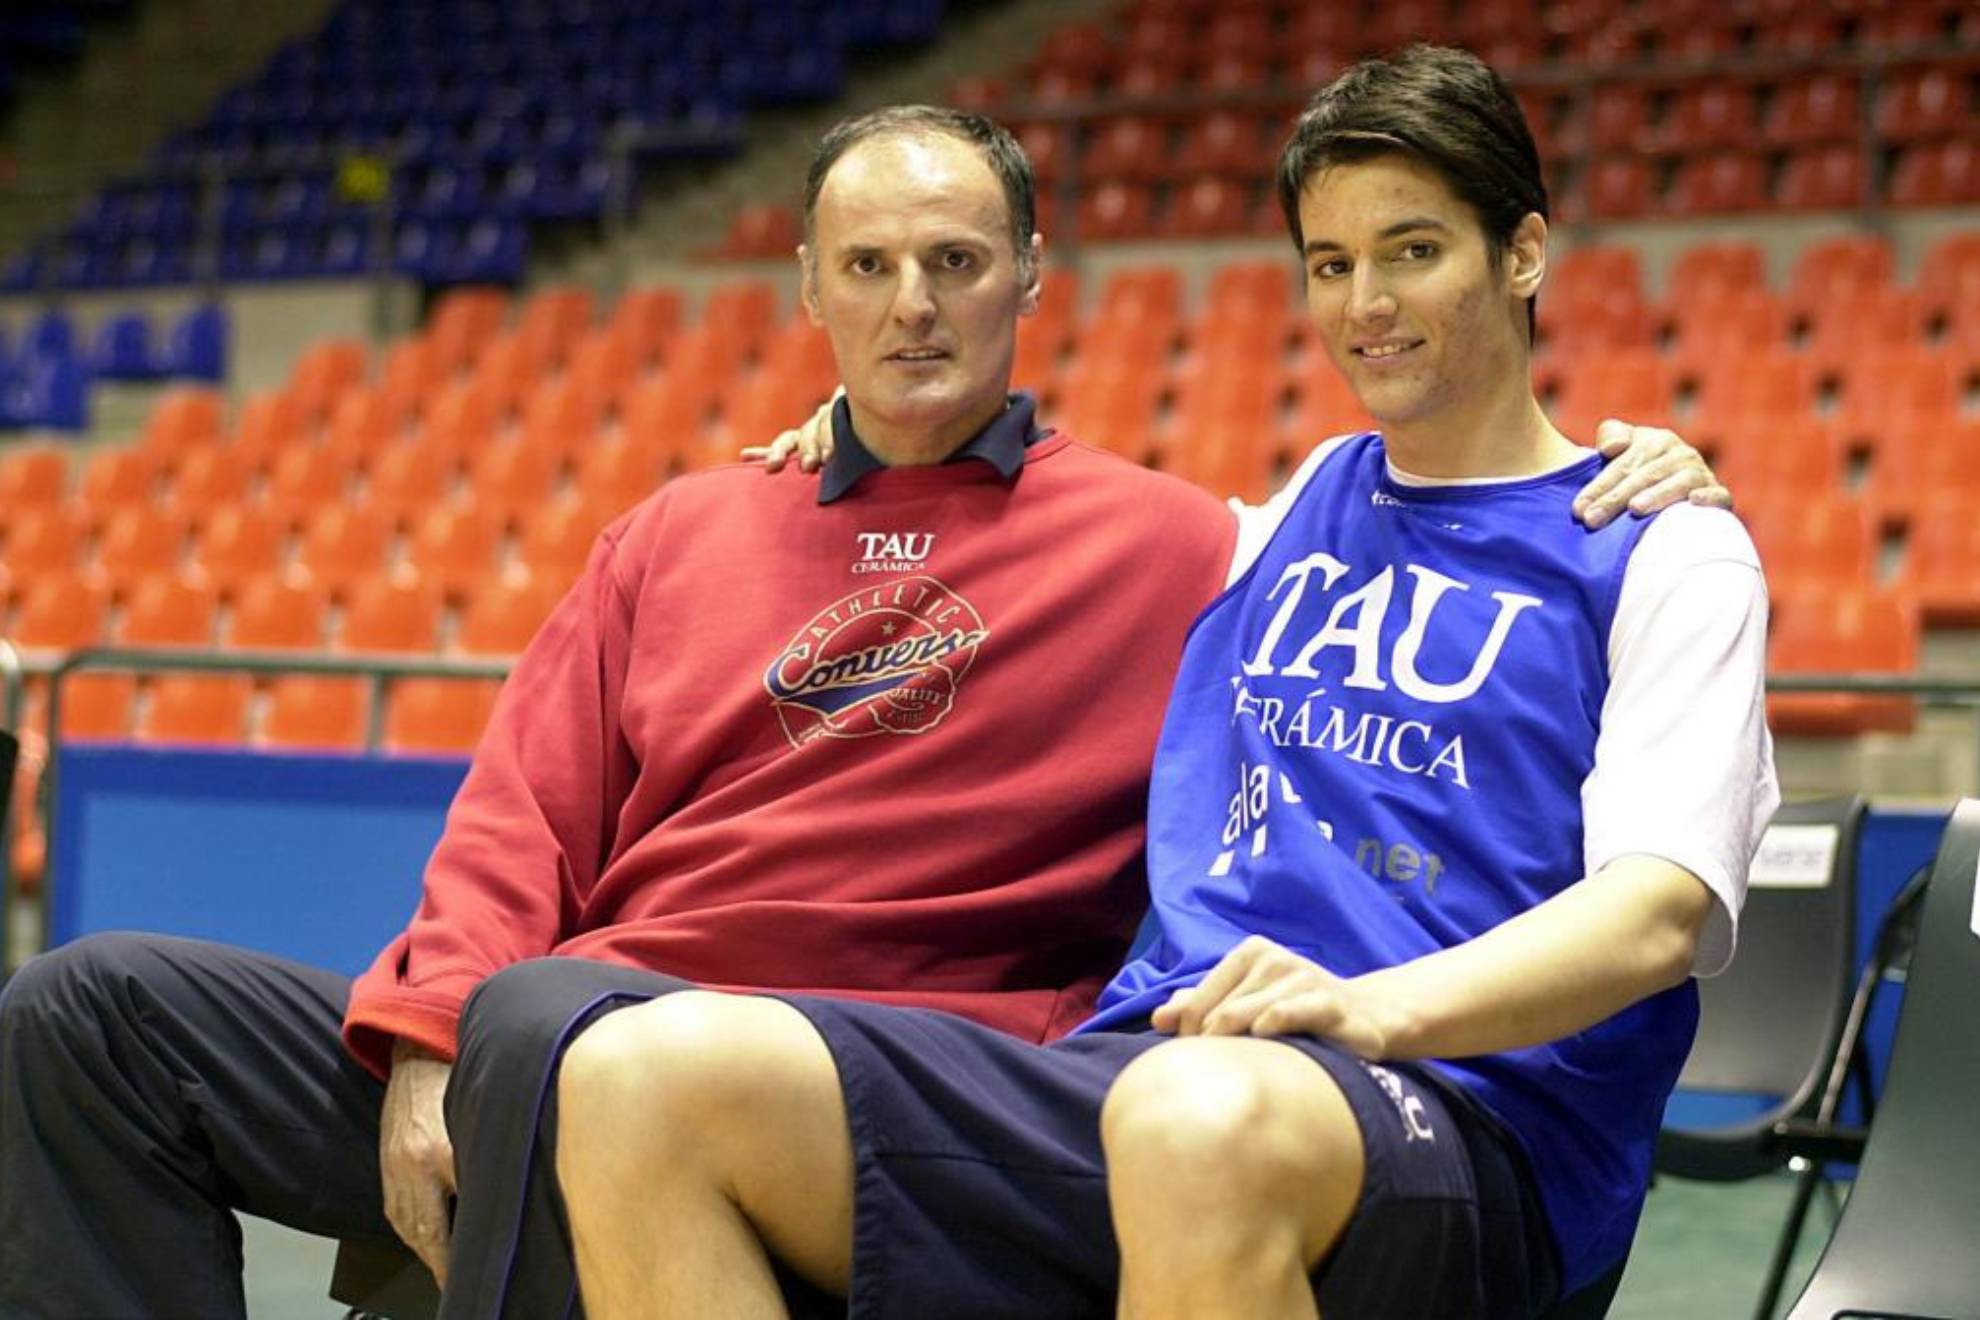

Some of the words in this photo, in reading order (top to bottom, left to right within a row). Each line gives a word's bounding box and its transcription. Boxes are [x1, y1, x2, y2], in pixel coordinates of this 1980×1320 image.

[857, 532, 936, 561] TAU
[810, 583, 961, 640] ATHLETIC
[1241, 552, 1543, 703] TAU
